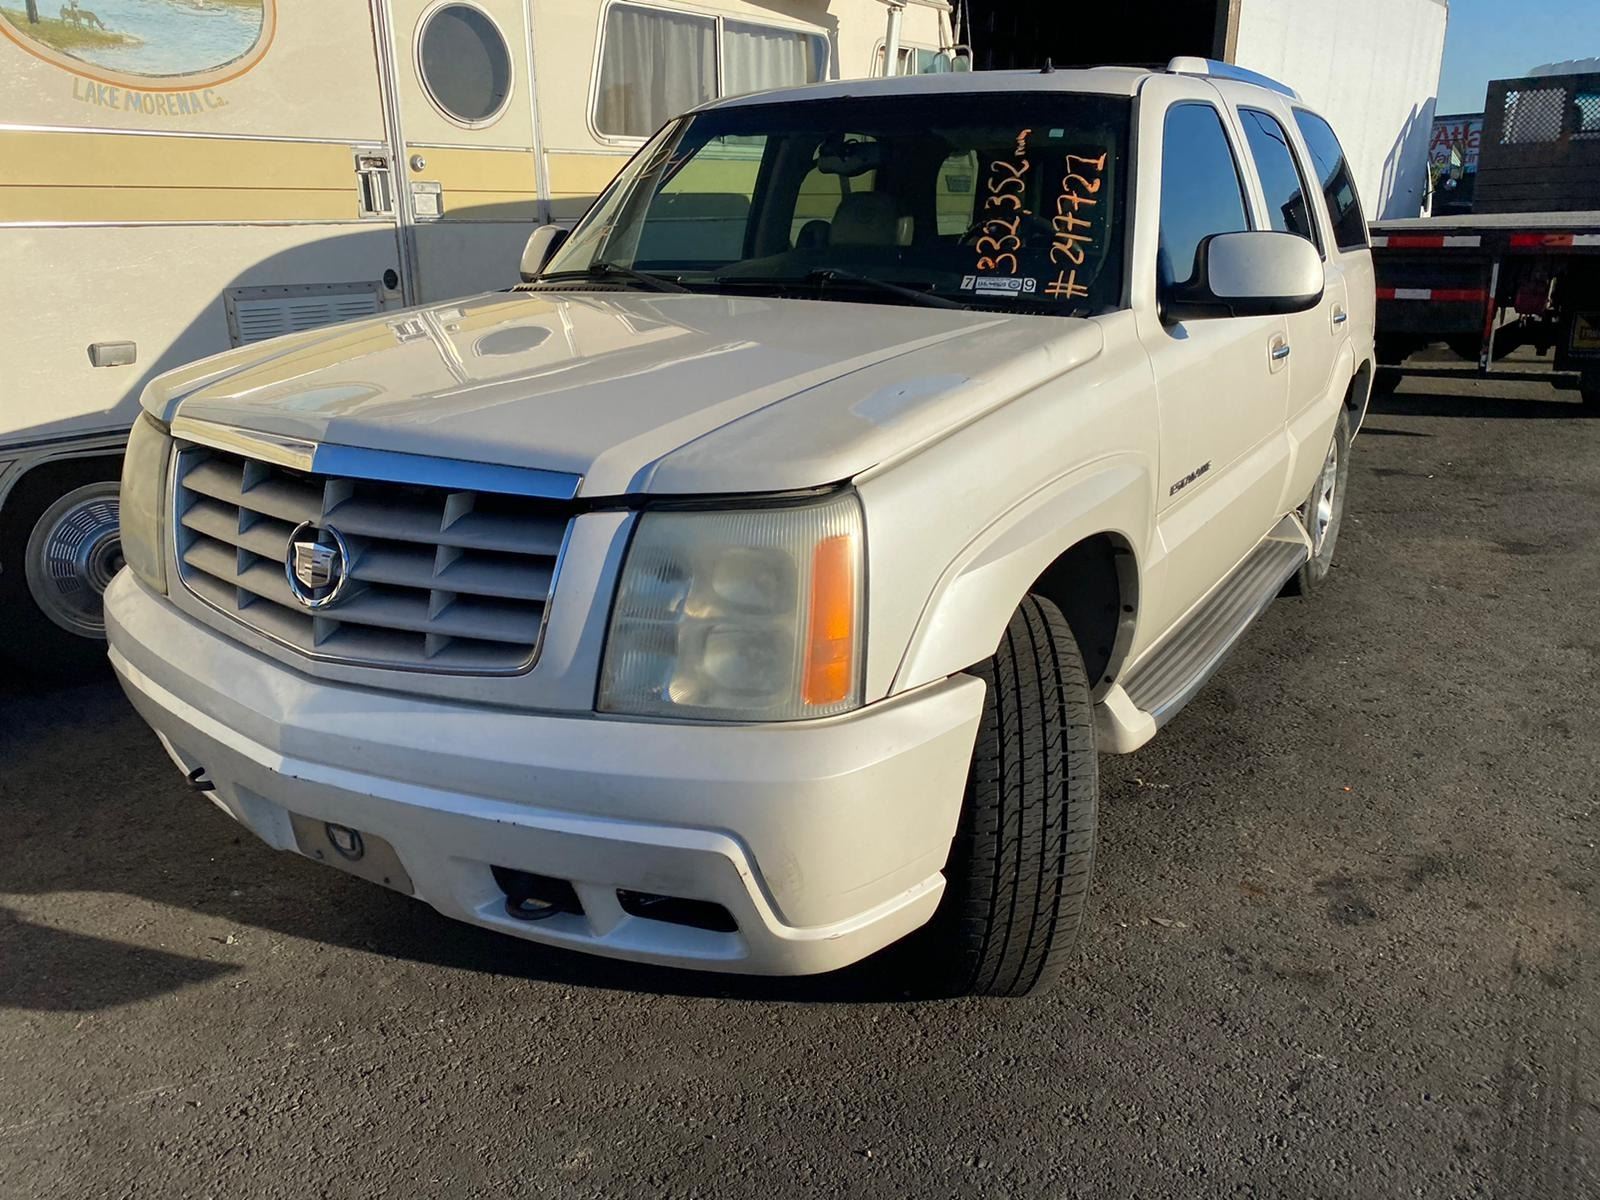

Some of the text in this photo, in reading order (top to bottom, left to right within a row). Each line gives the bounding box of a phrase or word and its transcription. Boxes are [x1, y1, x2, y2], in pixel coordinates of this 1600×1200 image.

[72, 77, 121, 111] LAKE
[124, 91, 203, 117] MORENA
[1024, 279, 1035, 292] 9
